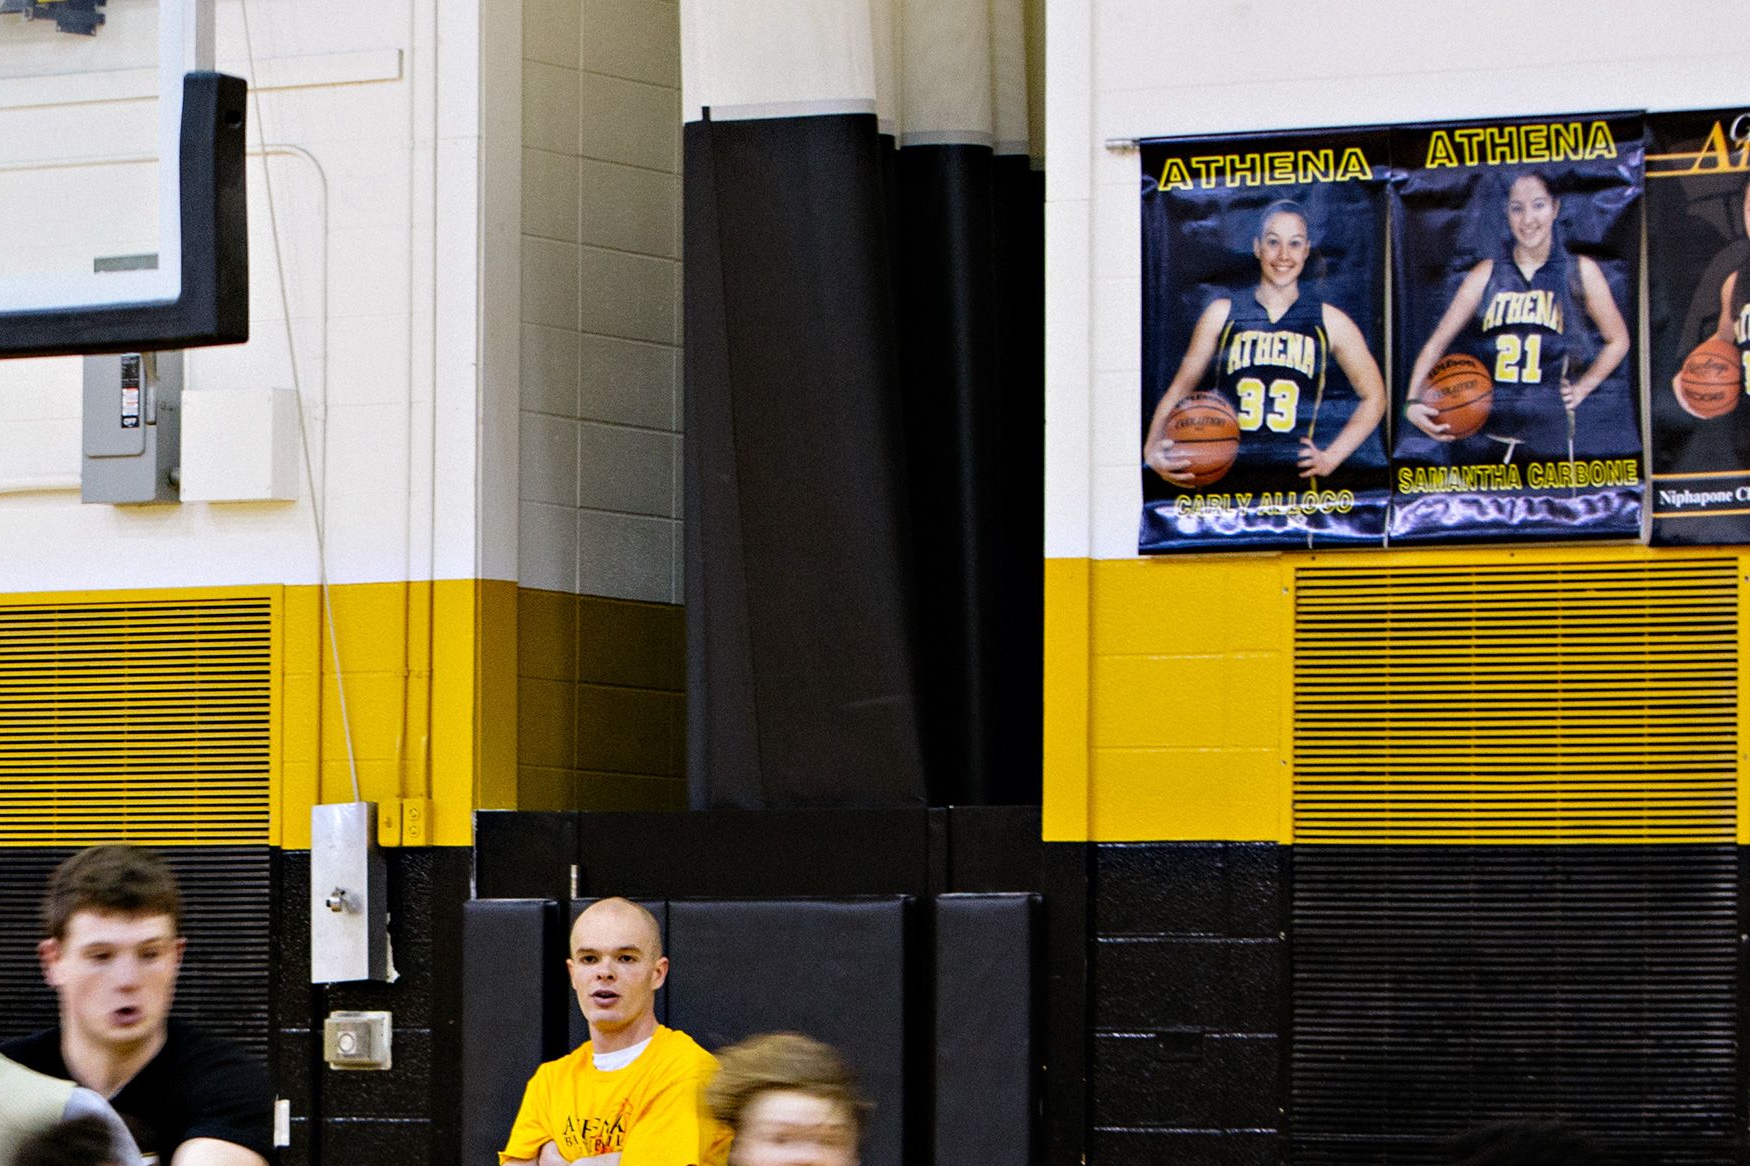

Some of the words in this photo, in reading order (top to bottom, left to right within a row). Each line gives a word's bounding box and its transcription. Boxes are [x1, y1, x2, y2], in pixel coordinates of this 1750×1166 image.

[1426, 120, 1618, 169] ATHENA
[1158, 147, 1373, 192] ATHENA
[1227, 330, 1316, 379] ATHENA
[1494, 333, 1542, 384] 21
[1236, 377, 1299, 432] 33
[1398, 463, 1523, 494] SAMANTHA
[1527, 459, 1639, 489] CARBONE
[1659, 488, 1733, 508] Niphapone
[1174, 493, 1252, 517] CARLY
